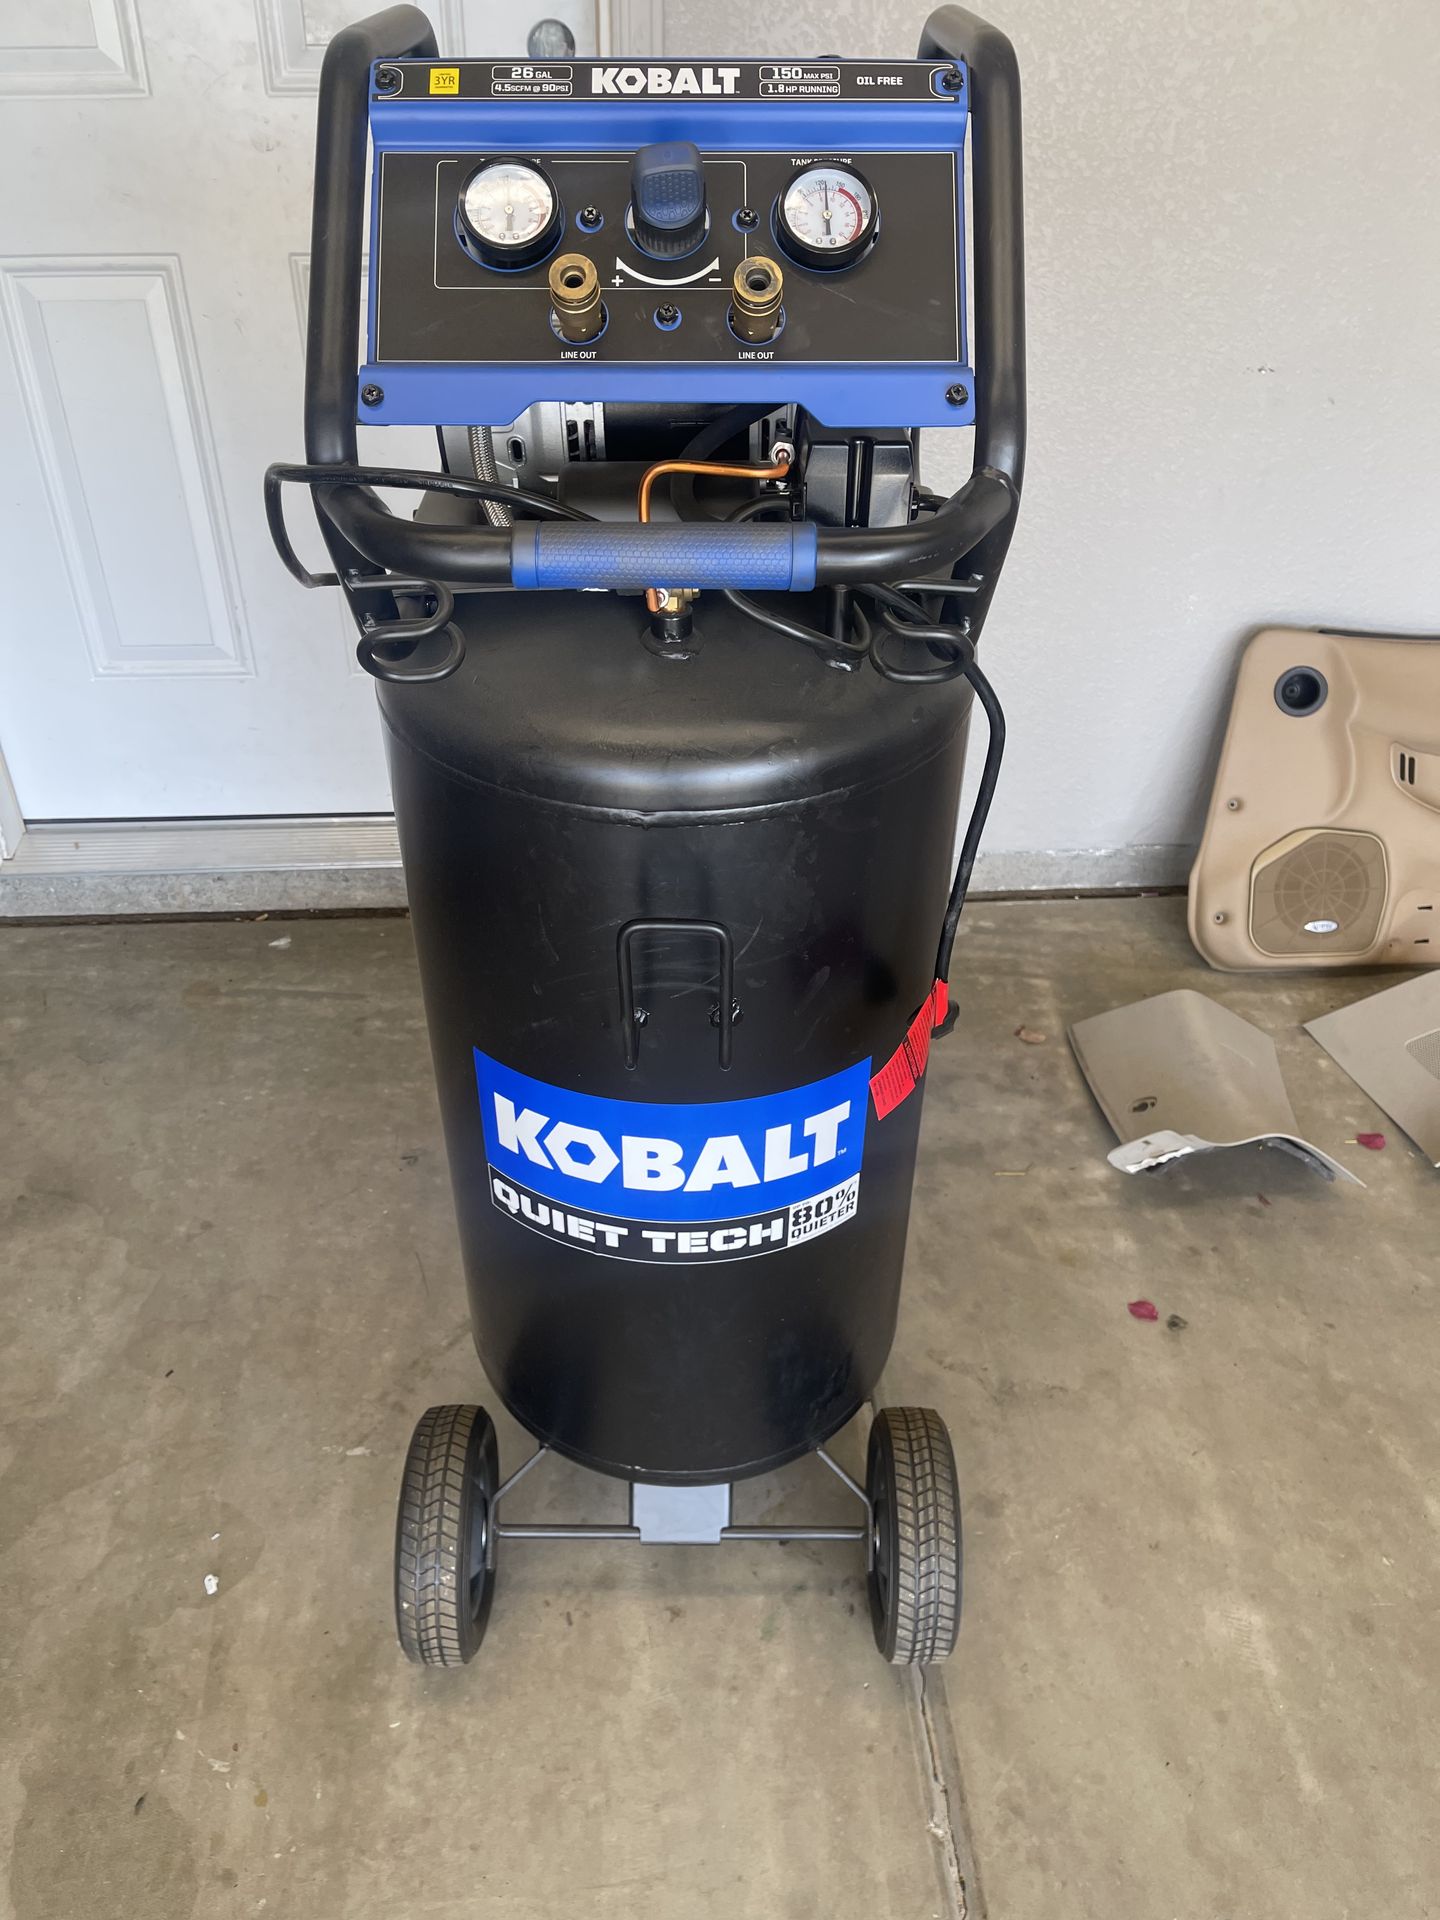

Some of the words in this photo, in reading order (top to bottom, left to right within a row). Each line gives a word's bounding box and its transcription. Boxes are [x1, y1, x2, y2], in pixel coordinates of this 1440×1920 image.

[511, 67, 534, 79] 26
[535, 70, 553, 79] GAL
[772, 67, 802, 79] 150
[434, 75, 455, 86] 3YR
[591, 67, 741, 95] KOBALT
[857, 76, 876, 85] OIL
[877, 76, 903, 85] FREE
[533, 84, 541, 93] @
[767, 83, 784, 93] 1.8
[785, 85, 797, 93] HP
[799, 85, 838, 93] RUNNING
[560, 351, 579, 359] LINE
[579, 351, 597, 359] OUT
[738, 351, 757, 359] LINE
[758, 351, 774, 359] OUT
[493, 1091, 851, 1193] KOBALT
[792, 1183, 856, 1227] 80%
[493, 1177, 629, 1249] QUIET
[641, 1218, 784, 1255] TECH
[791, 1200, 855, 1239] QUIETER
